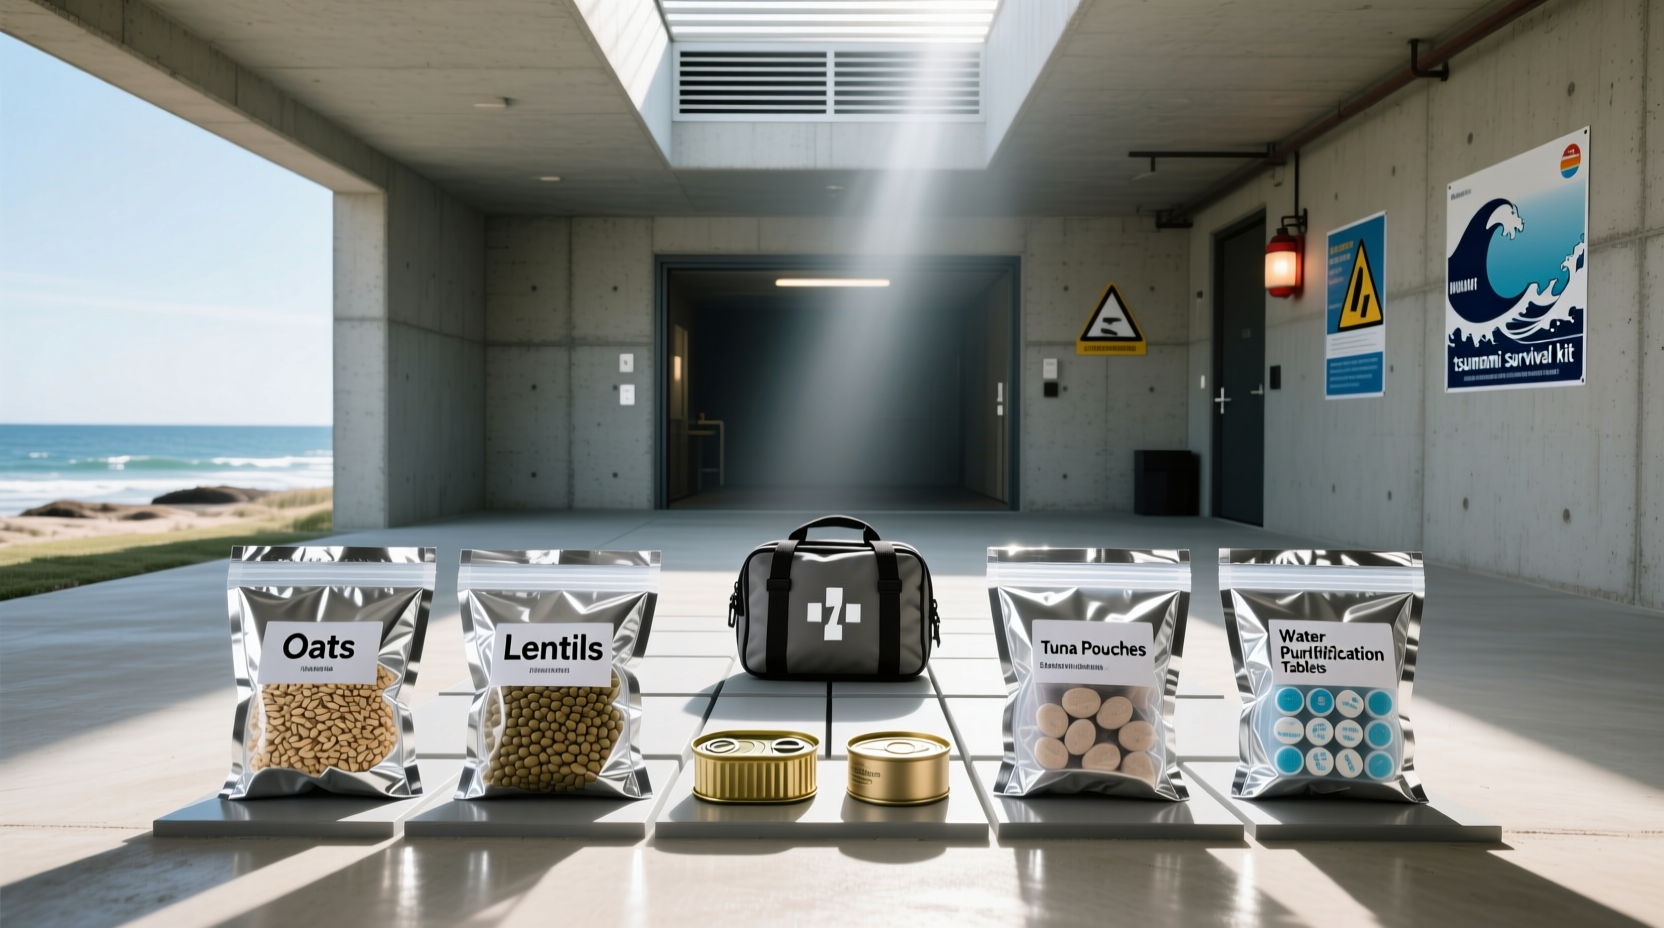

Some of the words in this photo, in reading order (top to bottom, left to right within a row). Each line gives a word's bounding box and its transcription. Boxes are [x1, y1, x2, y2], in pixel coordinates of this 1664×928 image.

[1504, 344, 1552, 367] survival
[1556, 343, 1575, 364] kit
[283, 632, 355, 659] Oats
[1279, 629, 1326, 643] Water
[504, 633, 603, 661] Lentils
[1041, 640, 1077, 655] Tuna
[1081, 640, 1147, 657] Pouches
[1281, 660, 1327, 673] Tablets
